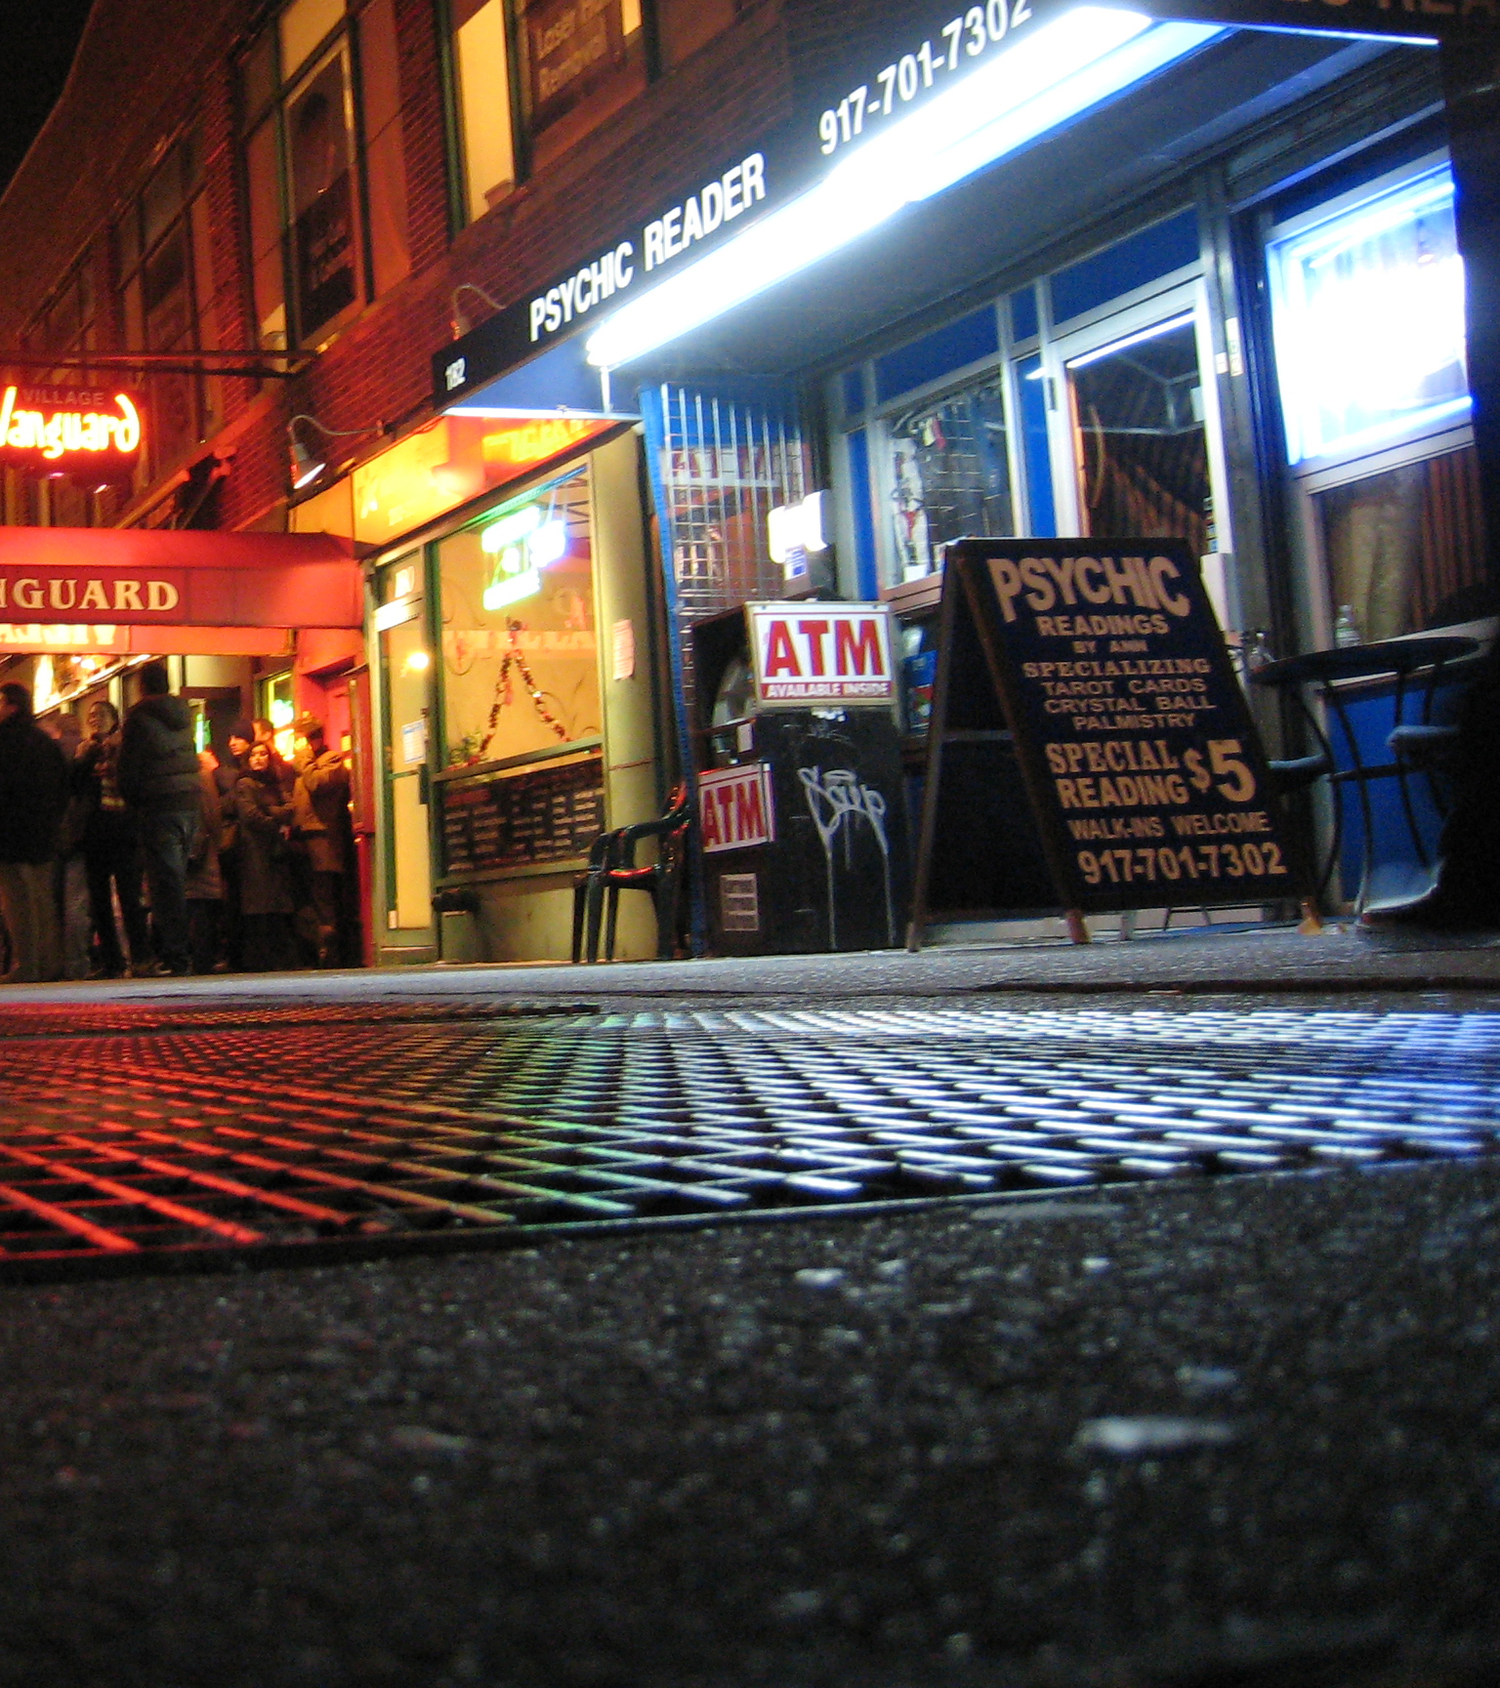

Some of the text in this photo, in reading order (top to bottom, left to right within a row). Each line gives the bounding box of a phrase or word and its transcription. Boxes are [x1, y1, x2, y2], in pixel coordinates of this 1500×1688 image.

[529, 0, 1033, 342] PSYCHIC READER 917-701-7302
[22, 388, 105, 406] VILLAGE
[986, 556, 1191, 623] PSYCHIC
[1035, 613, 1171, 636] READINGS
[764, 619, 884, 678] ATM
[1072, 640, 1097, 654] BY
[1022, 658, 1212, 678] SPECIALIZING
[766, 683, 889, 698] AVAILABLE INSIDE
[1041, 678, 1208, 695] TAROT CARDS
[1043, 695, 1218, 714] CRYSTAL BALL
[1072, 713, 1196, 730] PALMISTRY
[1045, 740, 1181, 774] SPECIAL
[1055, 739, 1257, 809] READING $5
[703, 779, 766, 847] ATM
[1067, 811, 1273, 840] WALK-INS WELCOME
[1077, 842, 1288, 884] 917-701-7302
